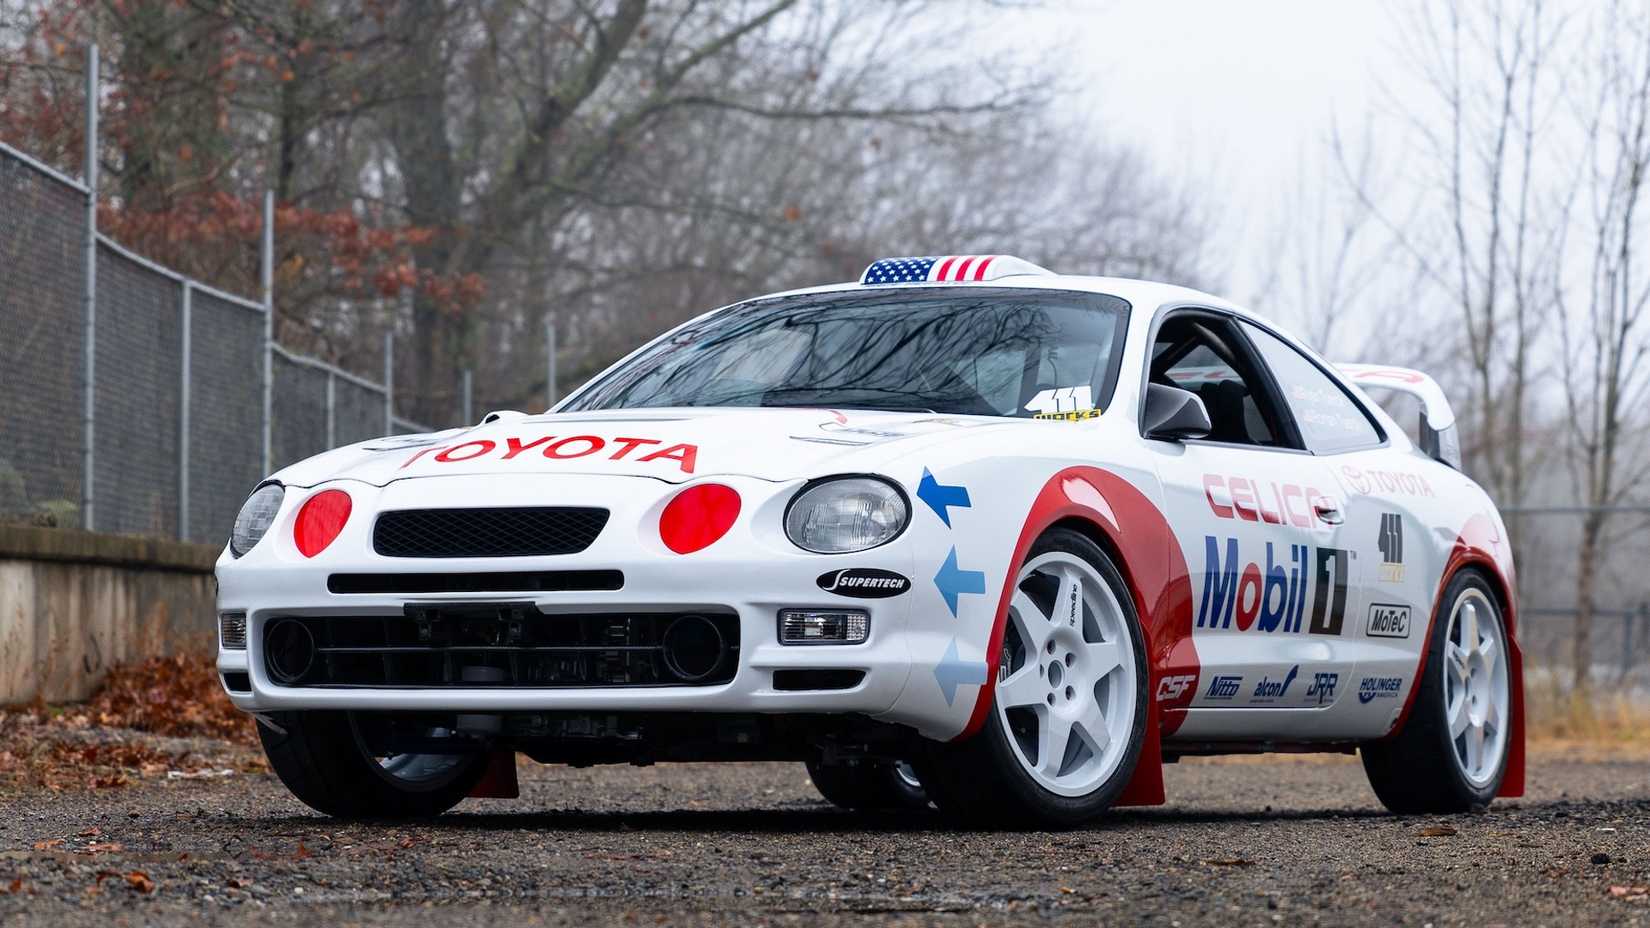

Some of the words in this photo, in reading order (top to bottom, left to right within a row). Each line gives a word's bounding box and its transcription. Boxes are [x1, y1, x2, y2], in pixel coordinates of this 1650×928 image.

[400, 435, 699, 473] TOYOTA
[1366, 470, 1435, 498] TOYOTA
[839, 576, 905, 588] SUPERTECH
[1197, 535, 1308, 634] Mobil
[1371, 609, 1406, 632] MoTeC
[1156, 675, 1197, 702] CSF
[1206, 676, 1243, 697] Nitto
[1360, 678, 1402, 691] HOLINGER
